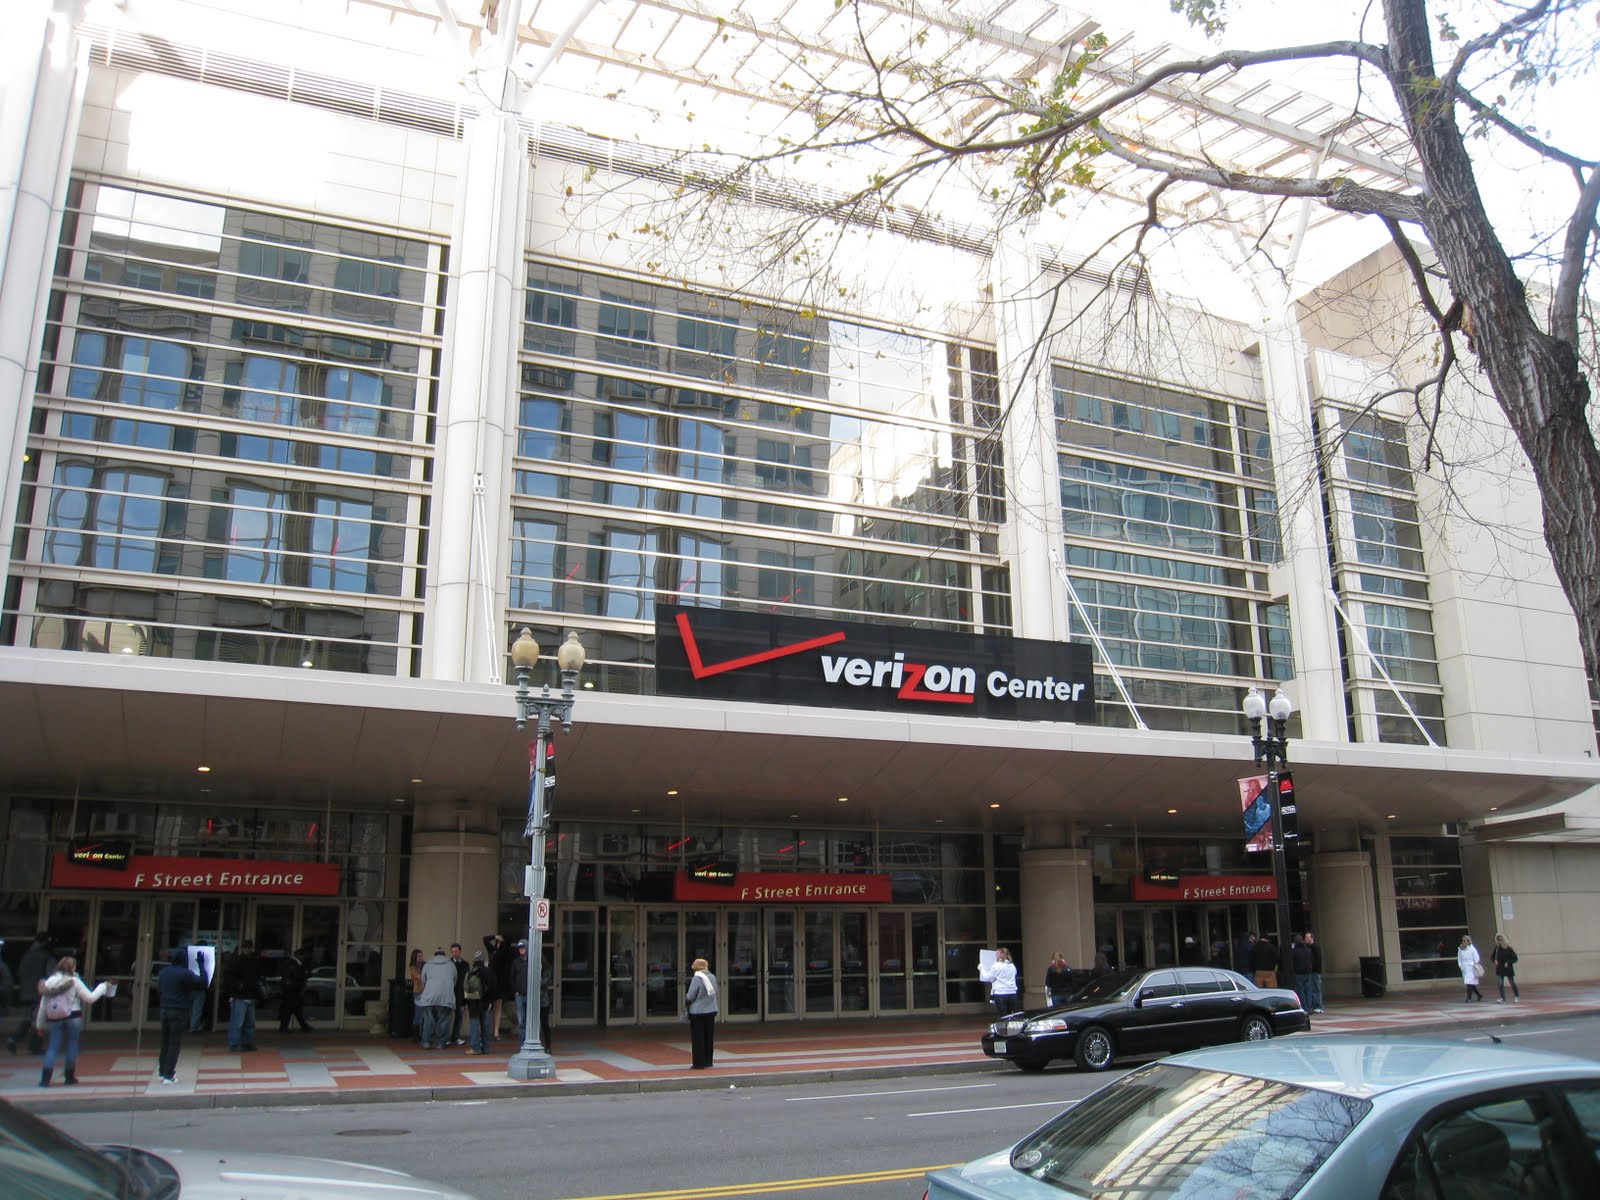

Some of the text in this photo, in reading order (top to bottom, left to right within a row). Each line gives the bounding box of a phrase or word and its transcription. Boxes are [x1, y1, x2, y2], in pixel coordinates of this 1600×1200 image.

[821, 652, 1085, 703] verizon Center
[134, 871, 304, 888] F Street Entrance
[741, 884, 867, 900] F Street Entrance
[1184, 884, 1272, 899] F Street Entrance
